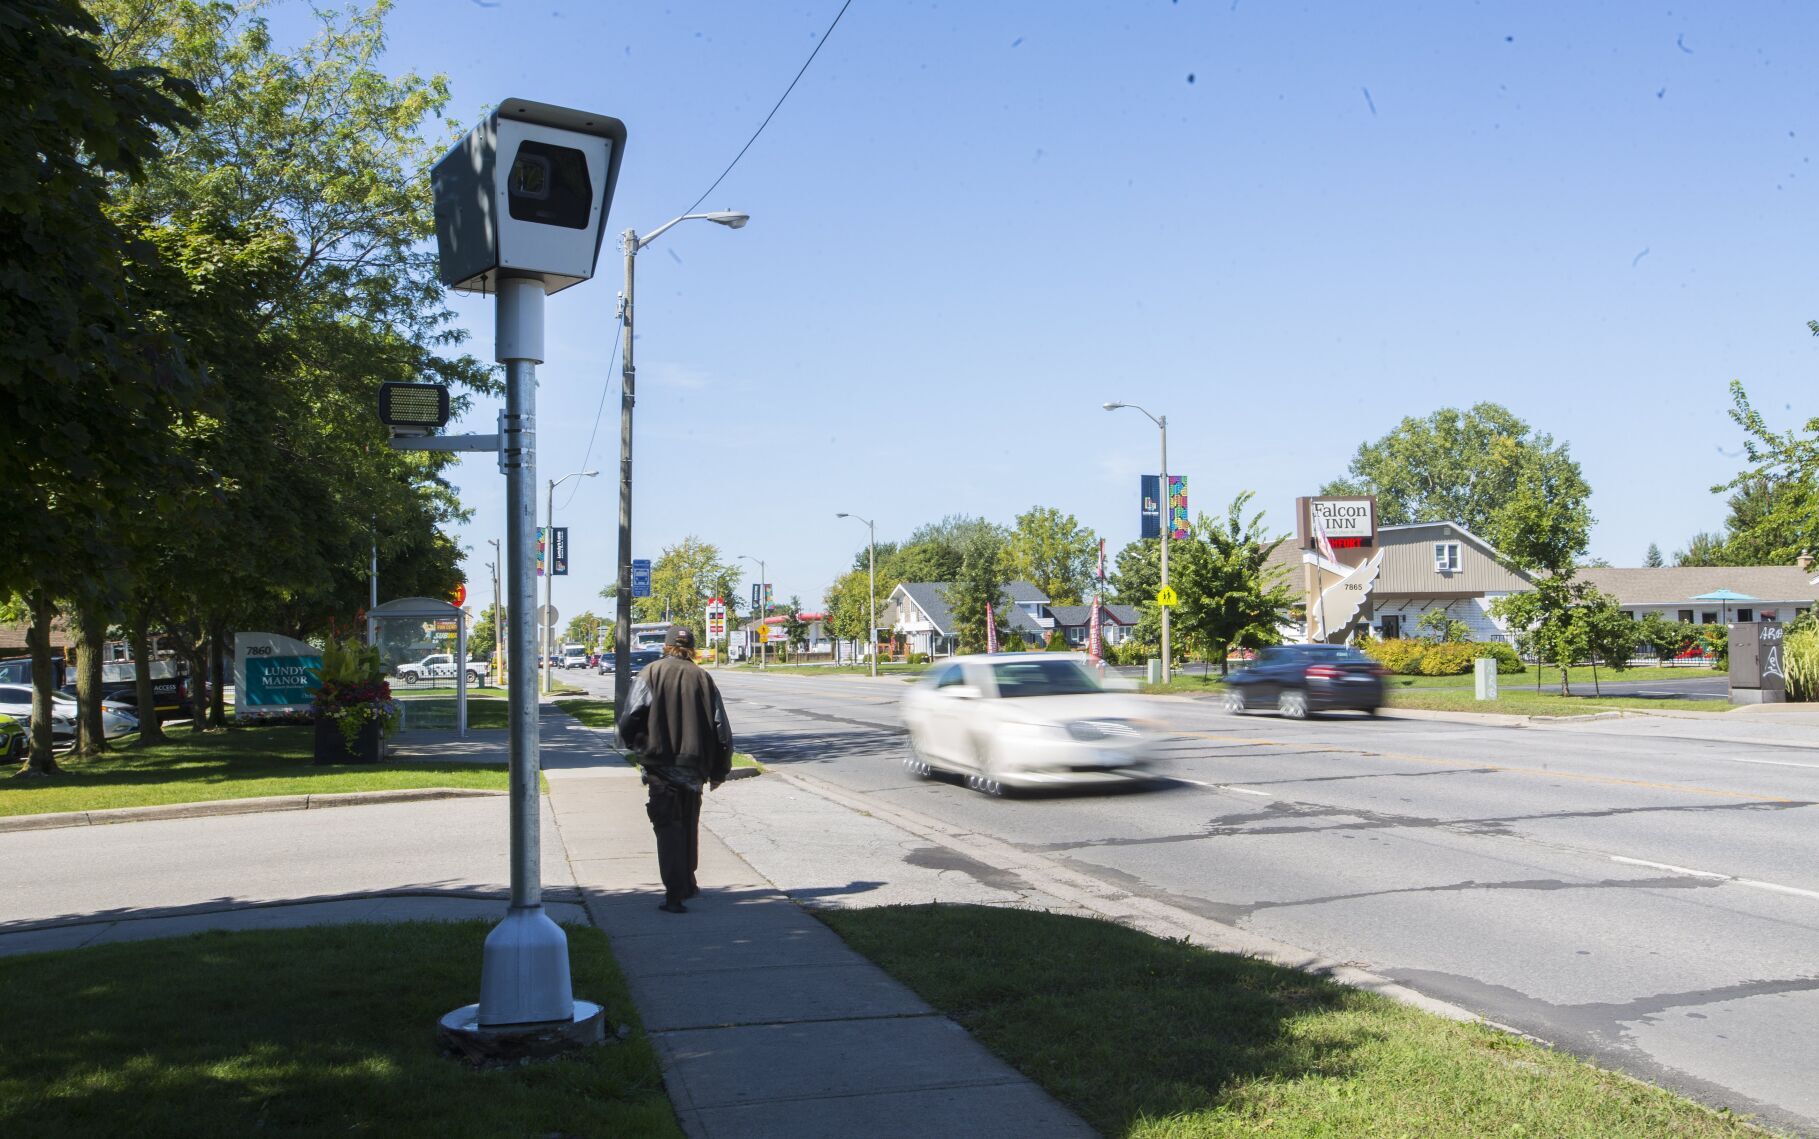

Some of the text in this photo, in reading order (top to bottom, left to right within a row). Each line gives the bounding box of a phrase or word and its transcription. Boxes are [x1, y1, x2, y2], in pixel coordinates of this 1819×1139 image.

[1313, 503, 1367, 518] Falcon
[1326, 518, 1356, 529] INN
[1344, 583, 1363, 591] 7865
[246, 646, 272, 656] 7860
[264, 666, 305, 676] LUNDY
[262, 676, 308, 685] MANOR
